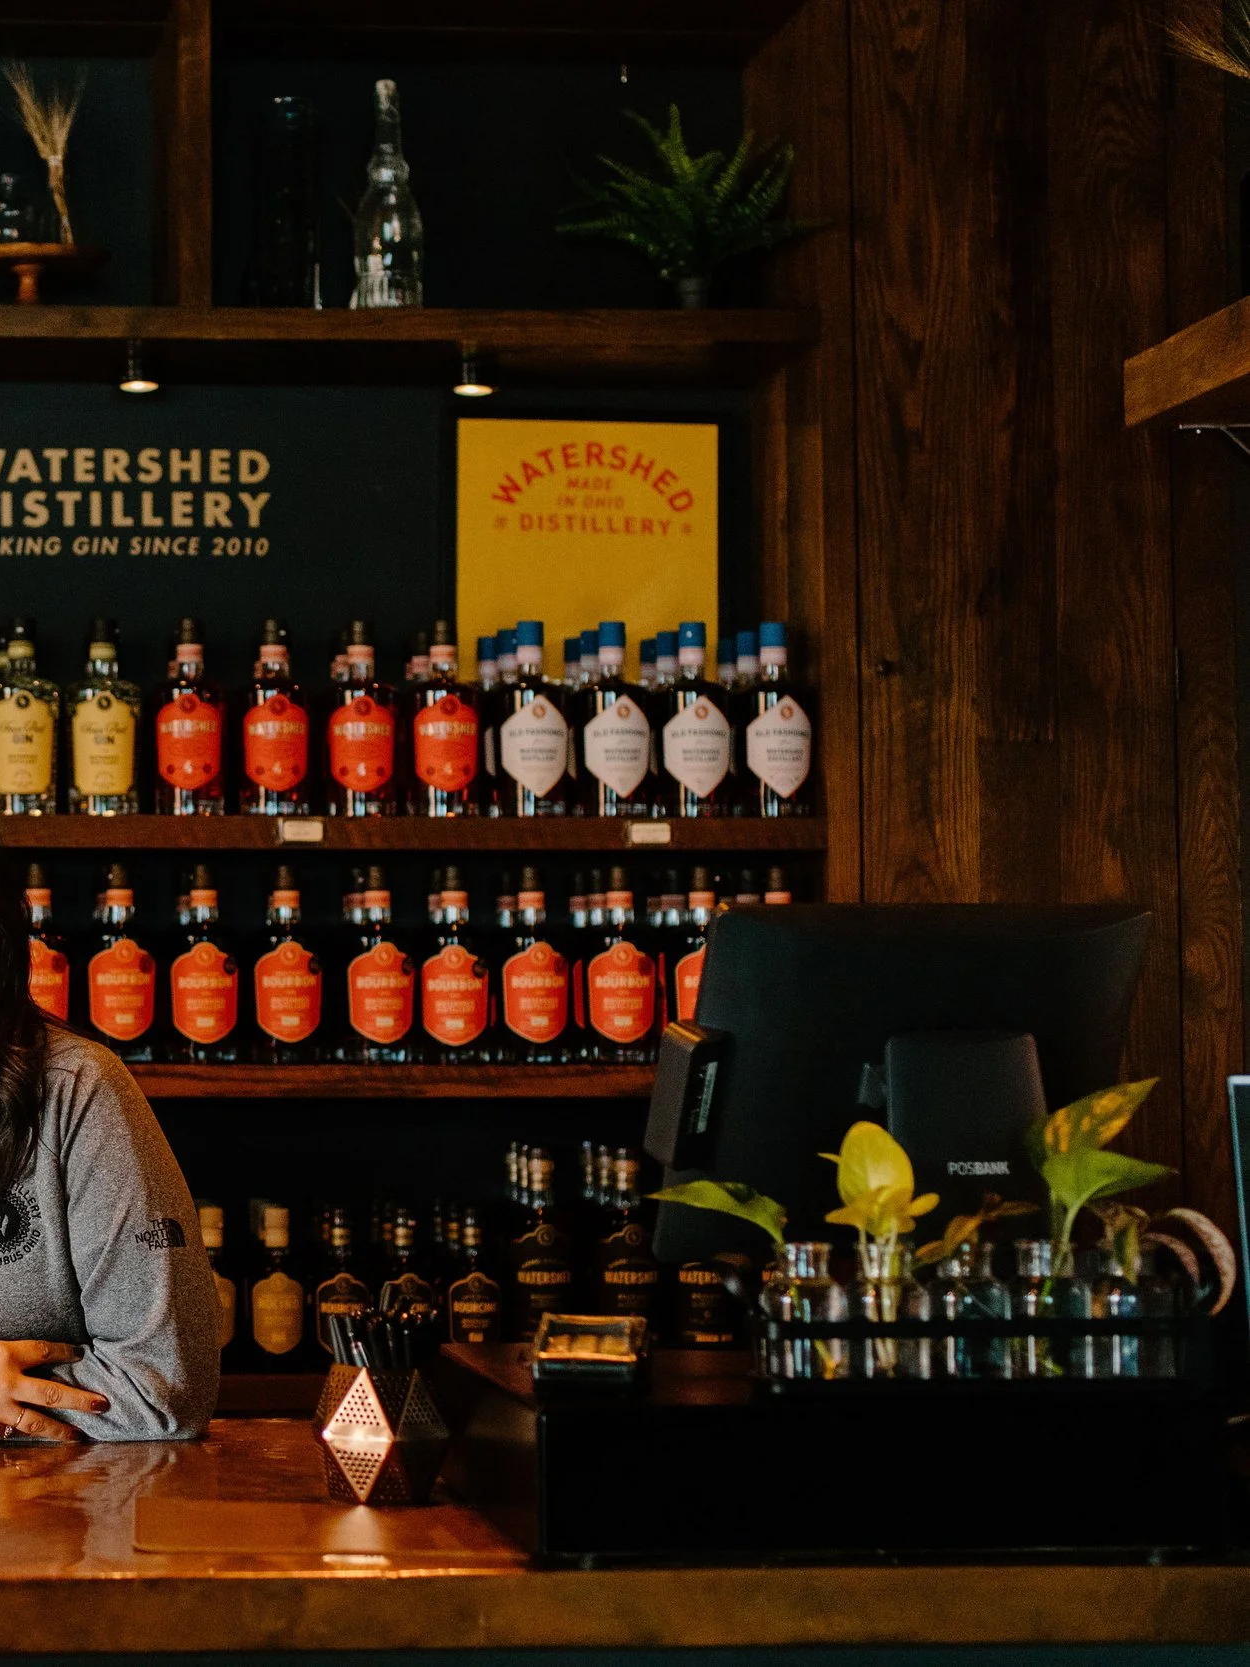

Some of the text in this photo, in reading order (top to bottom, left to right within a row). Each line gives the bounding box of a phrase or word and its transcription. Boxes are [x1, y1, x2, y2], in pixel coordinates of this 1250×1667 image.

[492, 441, 694, 513] WATERSHED
[566, 476, 613, 490] MADE
[519, 513, 671, 536] DISTILLERY
[72, 536, 119, 556] GIN
[129, 536, 200, 556] SINCE
[211, 536, 270, 556] 2010
[946, 1160, 1011, 1176] POSBANK
[150, 1217, 170, 1230] THE
[23, 1230, 41, 1253] OHIO
